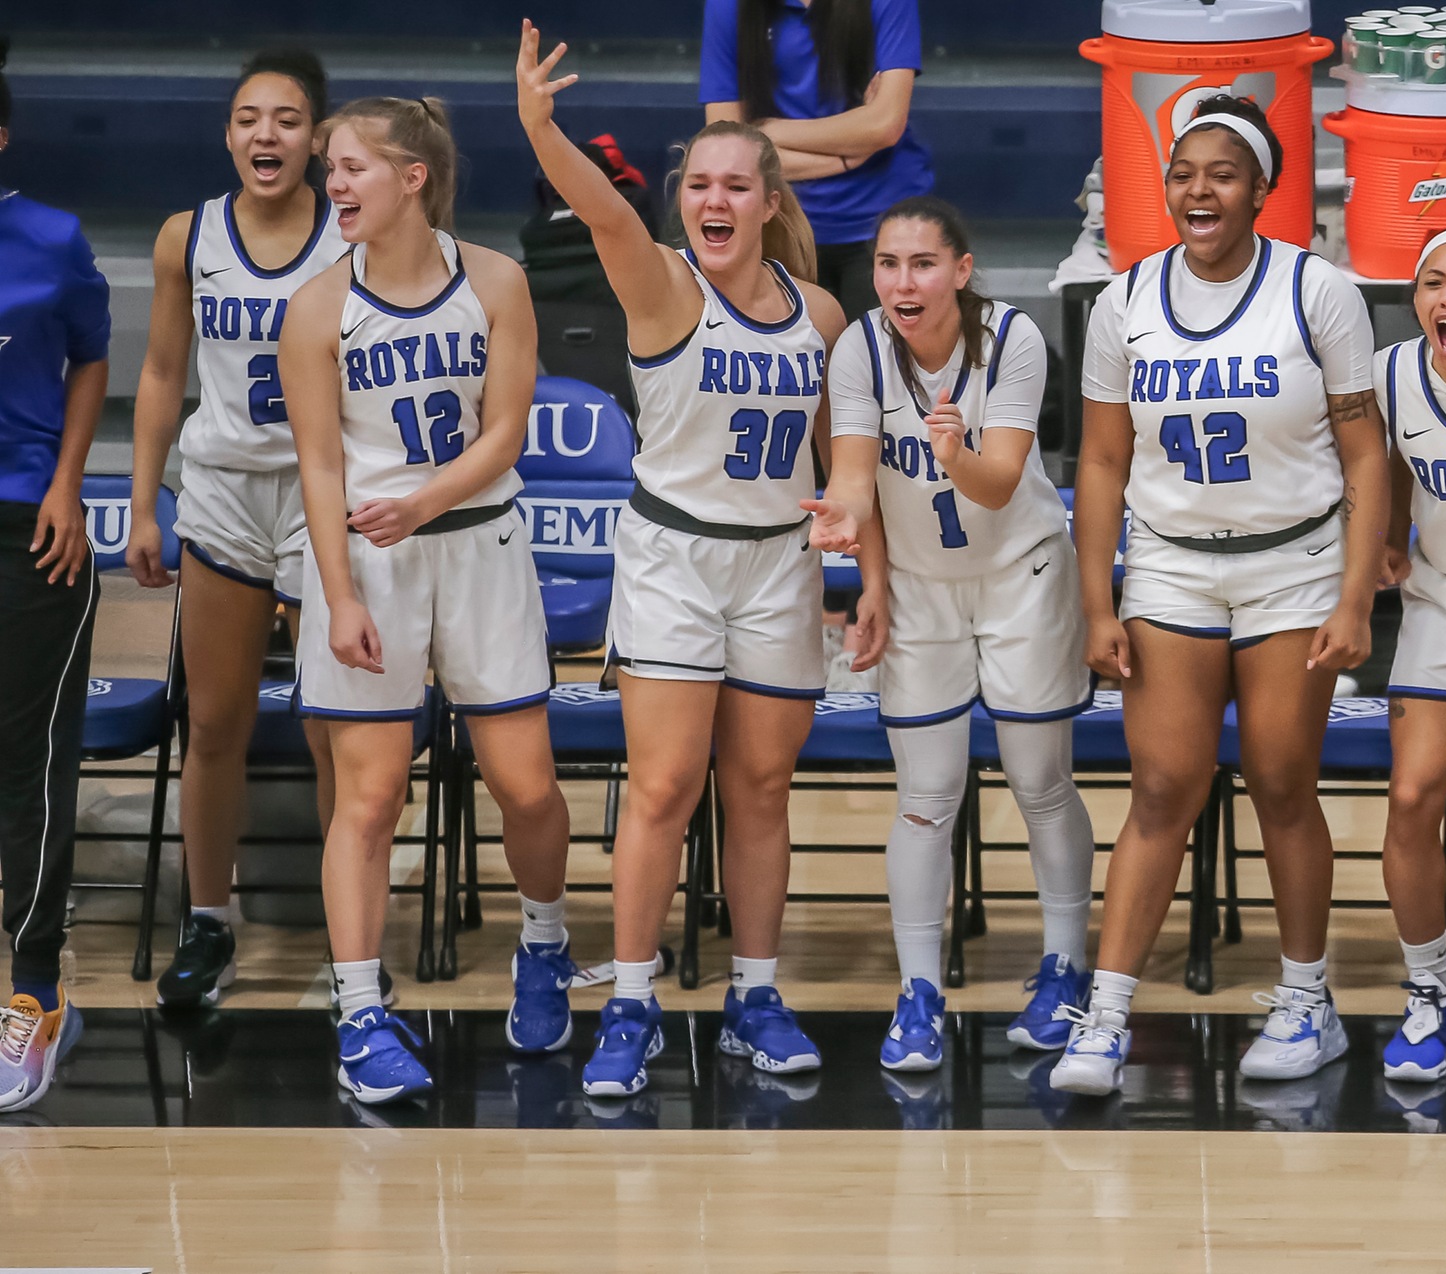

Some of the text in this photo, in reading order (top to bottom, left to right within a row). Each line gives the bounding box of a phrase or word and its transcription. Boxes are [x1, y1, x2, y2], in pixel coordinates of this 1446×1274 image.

[200, 296, 288, 341] ROYA
[345, 332, 488, 391] ROYALS
[1131, 355, 1280, 402] ROYALS
[391, 389, 464, 467] 12
[723, 408, 807, 481] 30
[1159, 412, 1252, 484] 42
[530, 505, 621, 547] EM
[932, 488, 968, 548] 1
